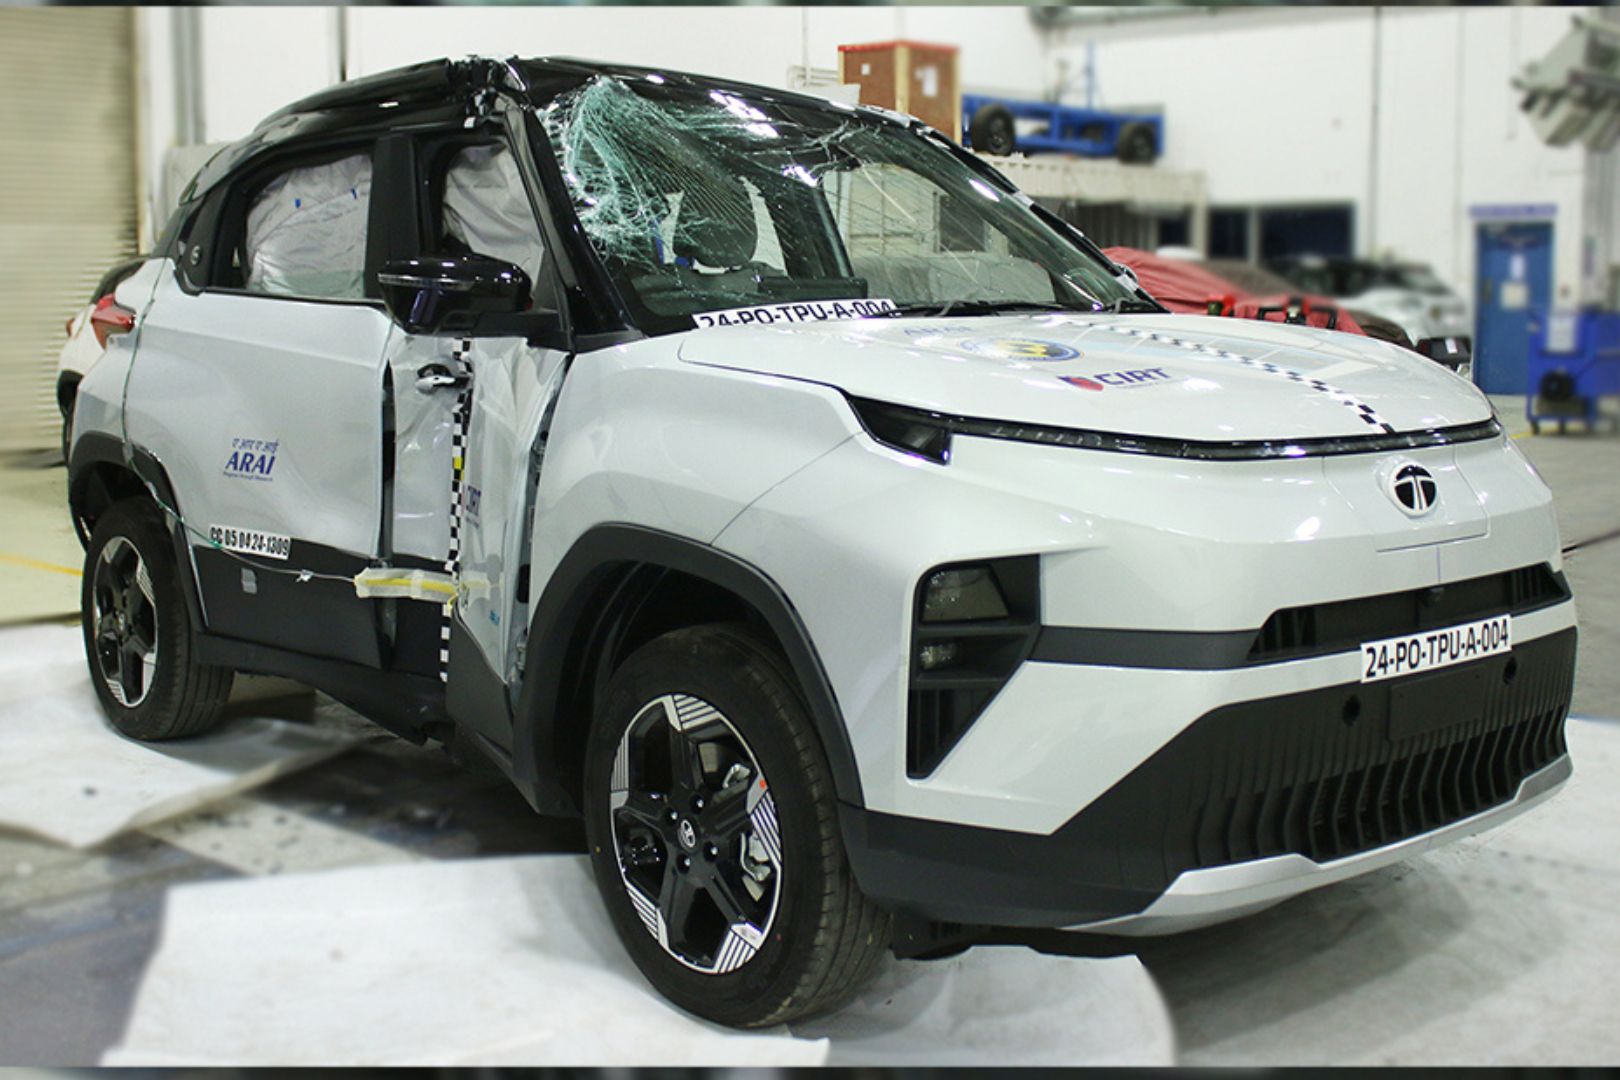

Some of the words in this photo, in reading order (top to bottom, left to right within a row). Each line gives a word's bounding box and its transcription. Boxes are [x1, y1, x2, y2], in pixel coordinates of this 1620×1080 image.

[1094, 367, 1171, 386] CIRT
[225, 450, 275, 475] ARAI
[1366, 618, 1508, 678] 24-PO-TPU-A-004
